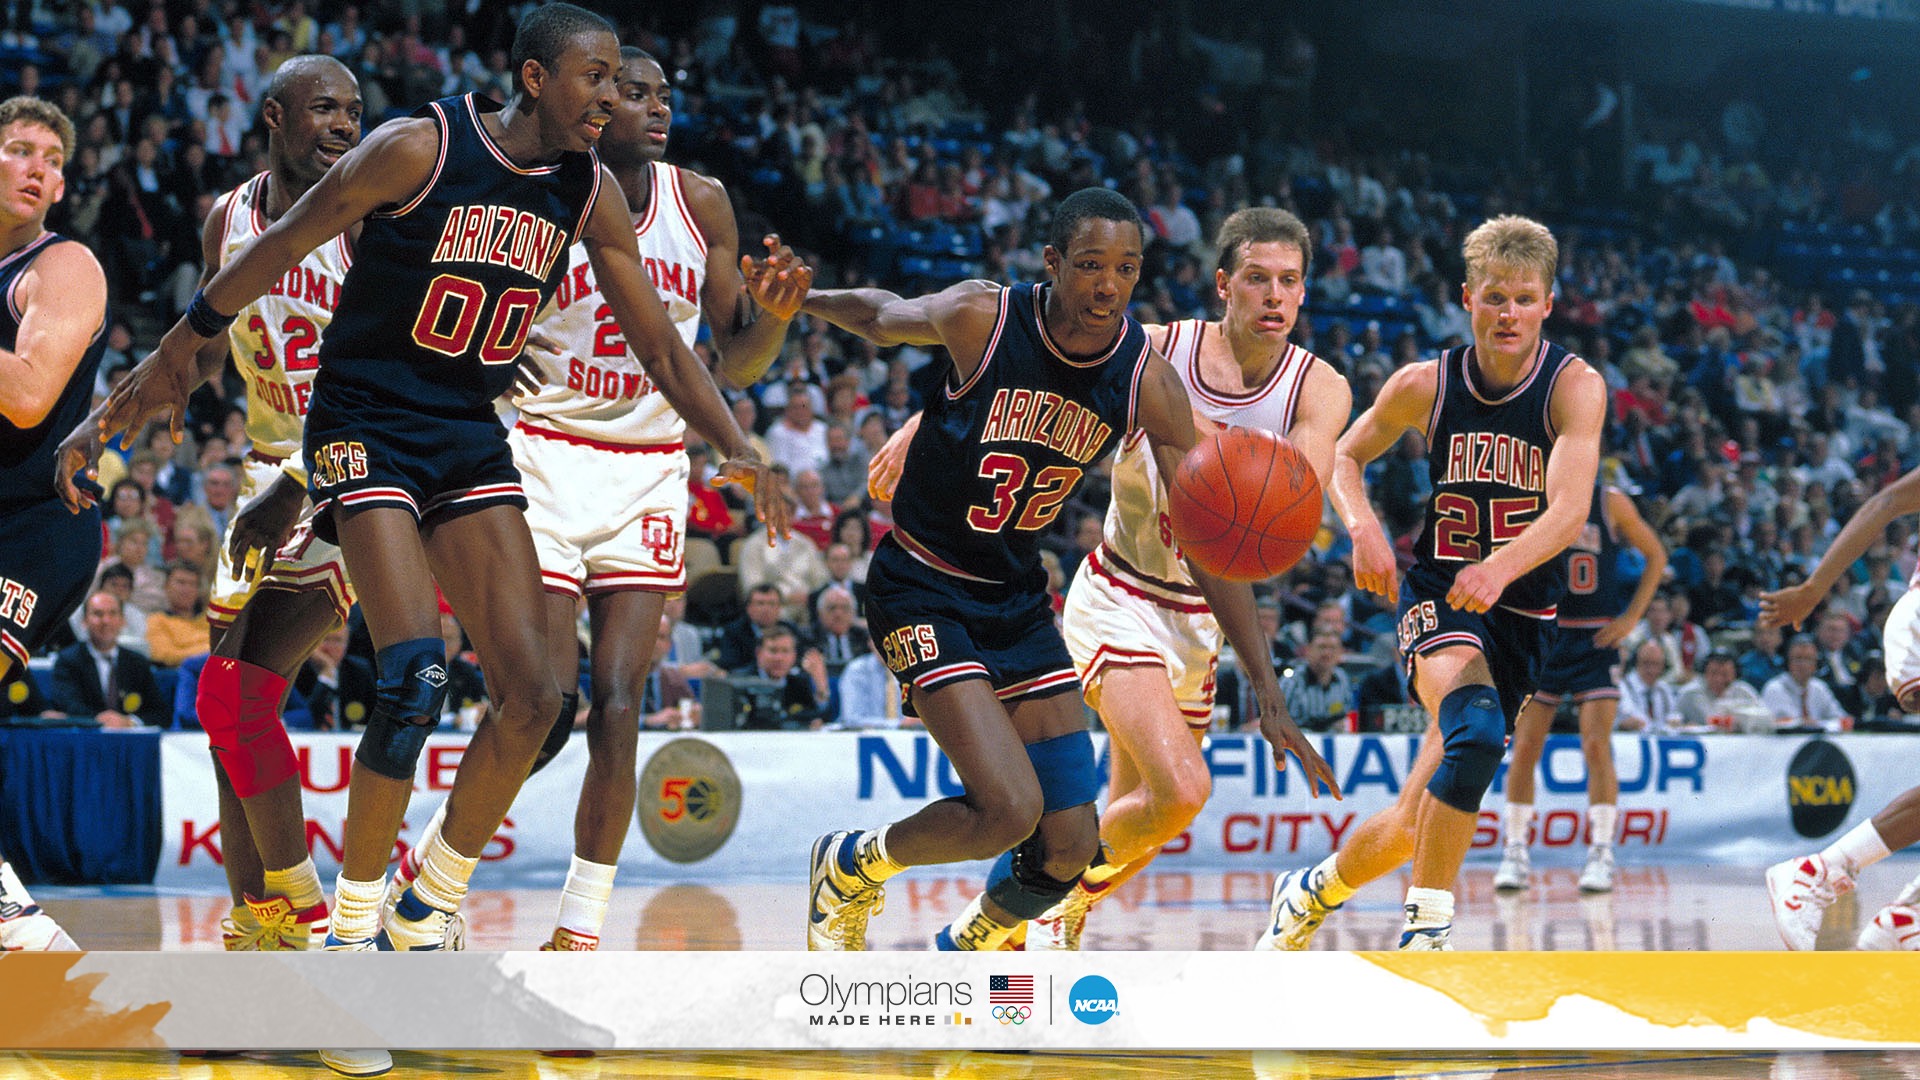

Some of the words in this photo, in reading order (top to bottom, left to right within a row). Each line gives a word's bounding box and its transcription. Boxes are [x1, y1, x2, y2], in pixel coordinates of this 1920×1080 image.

[431, 204, 567, 283] ARIZONA
[248, 314, 320, 372] 32
[411, 273, 541, 366] 00
[593, 303, 628, 357] 2
[980, 388, 1112, 464] ARIZONA
[966, 451, 1083, 533] 32
[1437, 432, 1545, 492] RIZONA
[1434, 492, 1539, 562] 25
[0, 577, 38, 629] TS
[1789, 776, 1853, 806] NCAA
[1223, 812, 1356, 854] CITY
